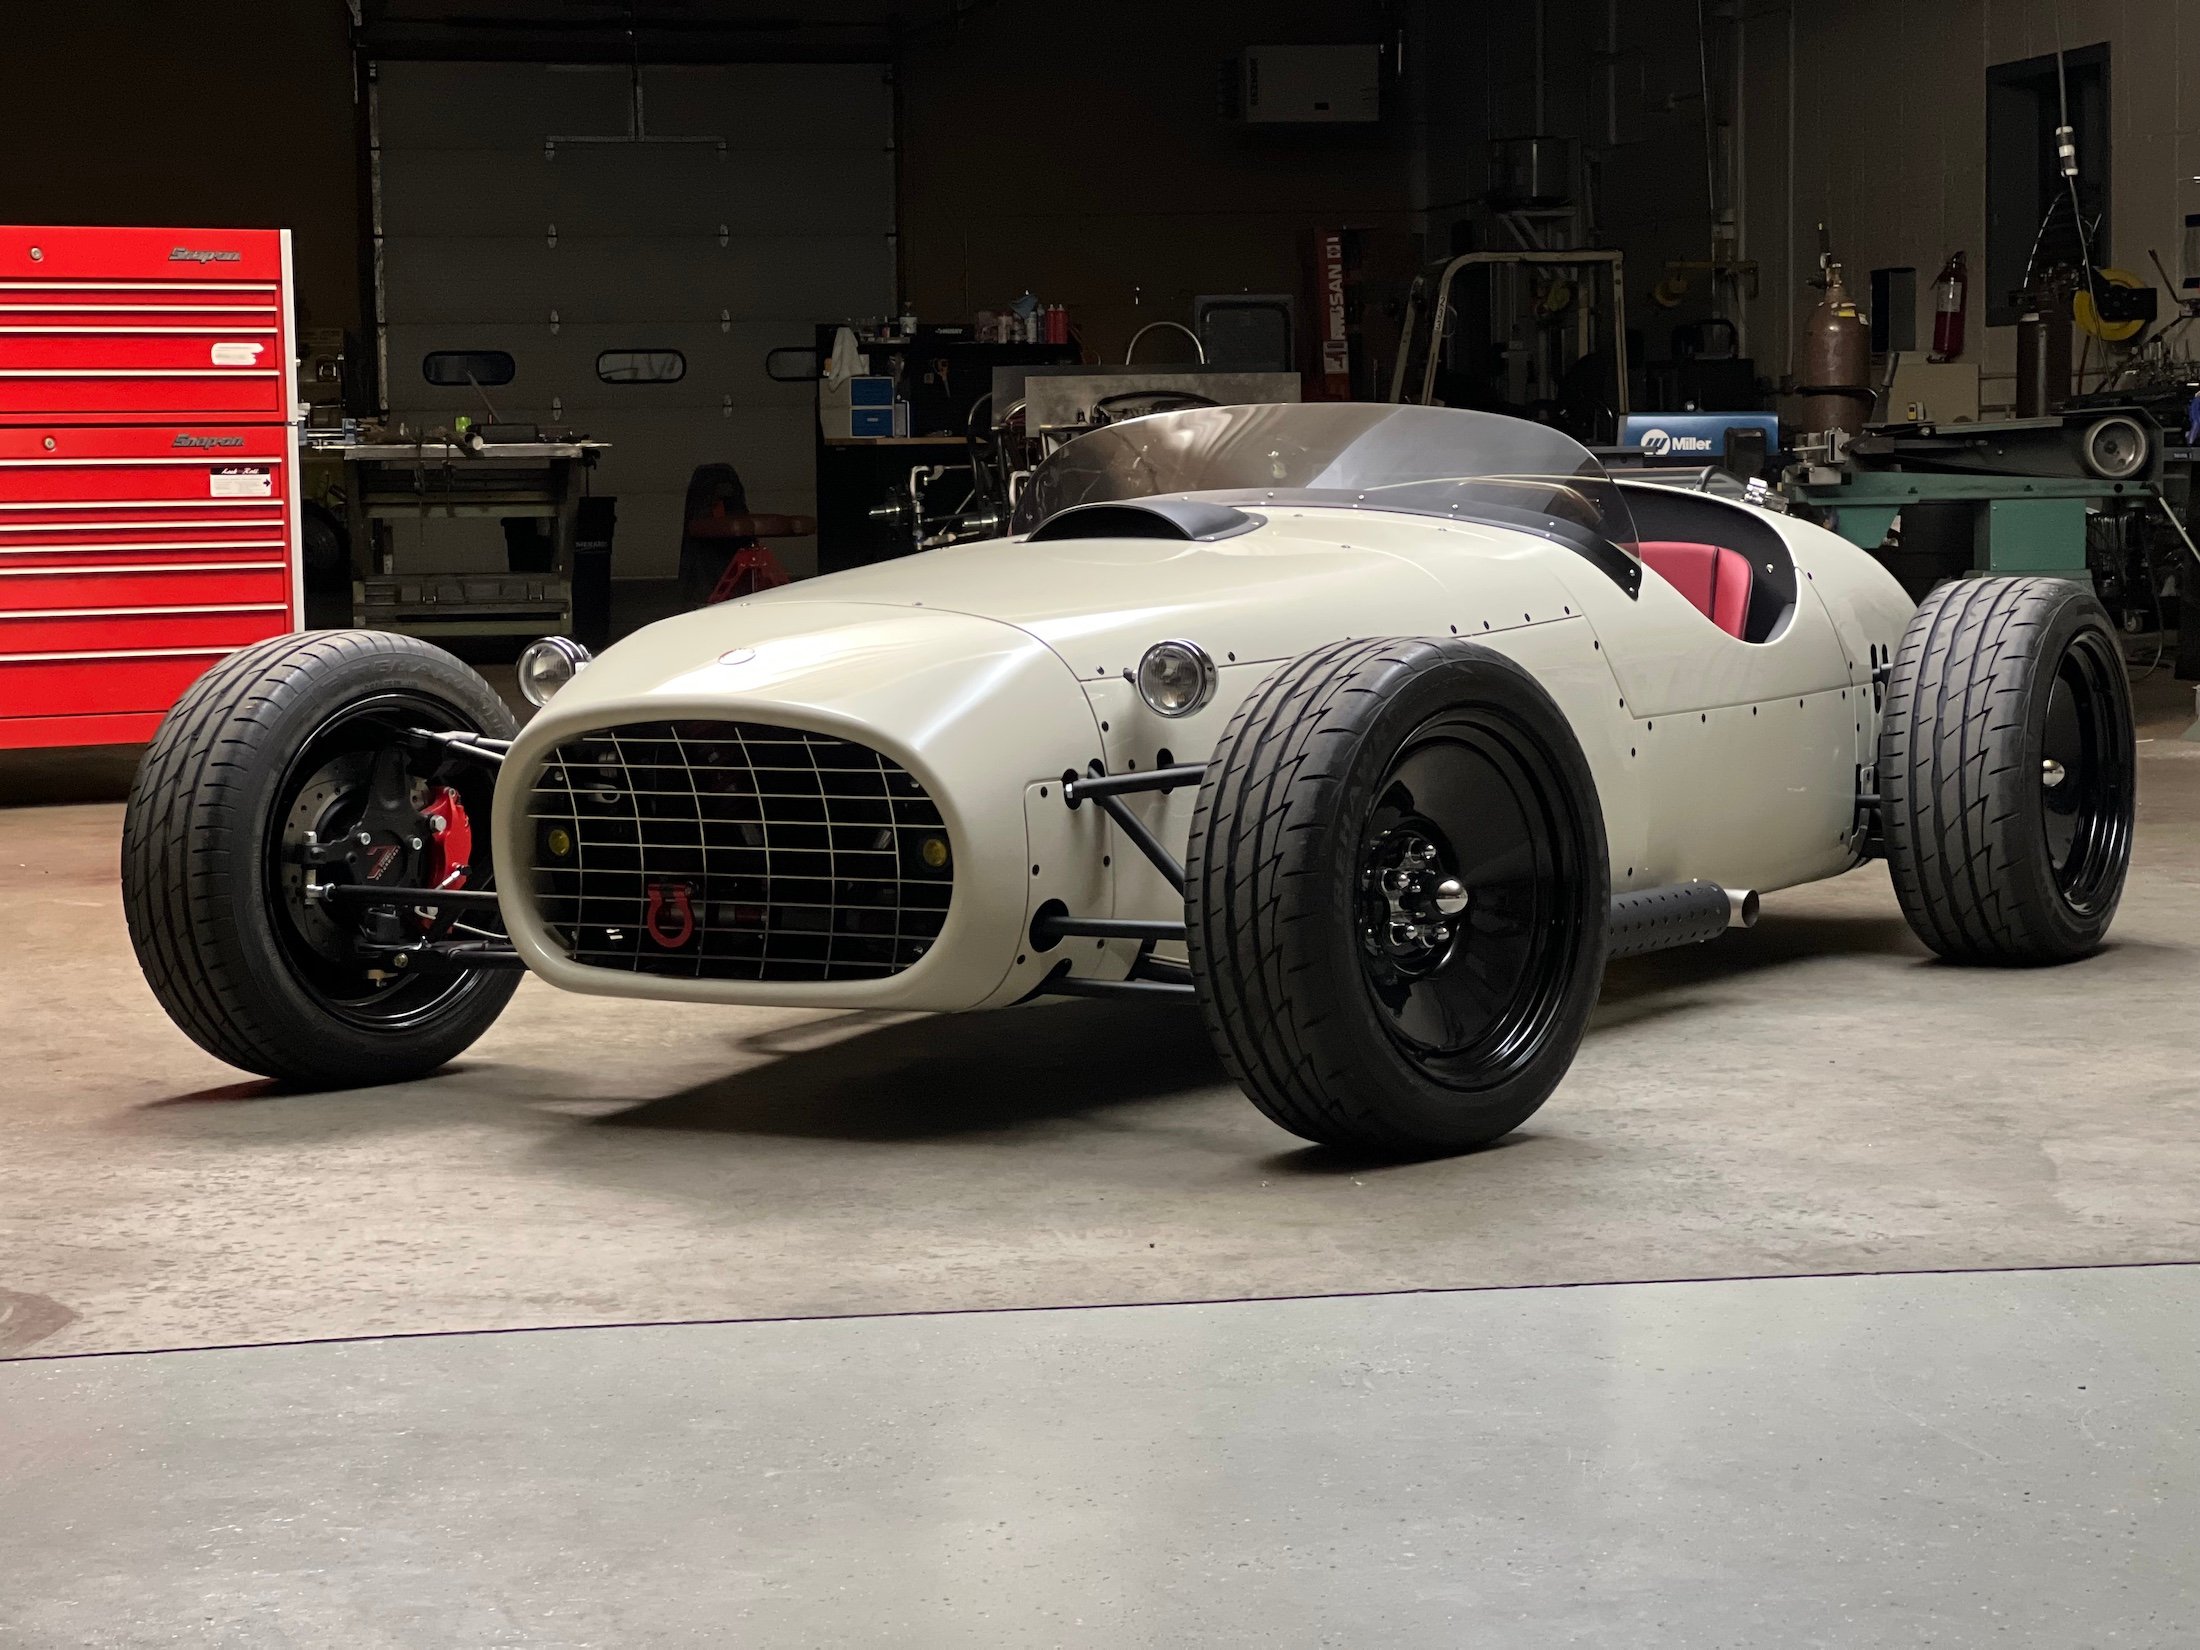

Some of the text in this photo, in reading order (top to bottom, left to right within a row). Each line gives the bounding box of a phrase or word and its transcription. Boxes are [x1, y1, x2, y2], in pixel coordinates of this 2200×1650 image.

[168, 247, 241, 264] Snap-on
[1327, 263, 1346, 341] SSAN
[172, 433, 245, 450] Snap-on
[1671, 436, 1712, 451] Miller
